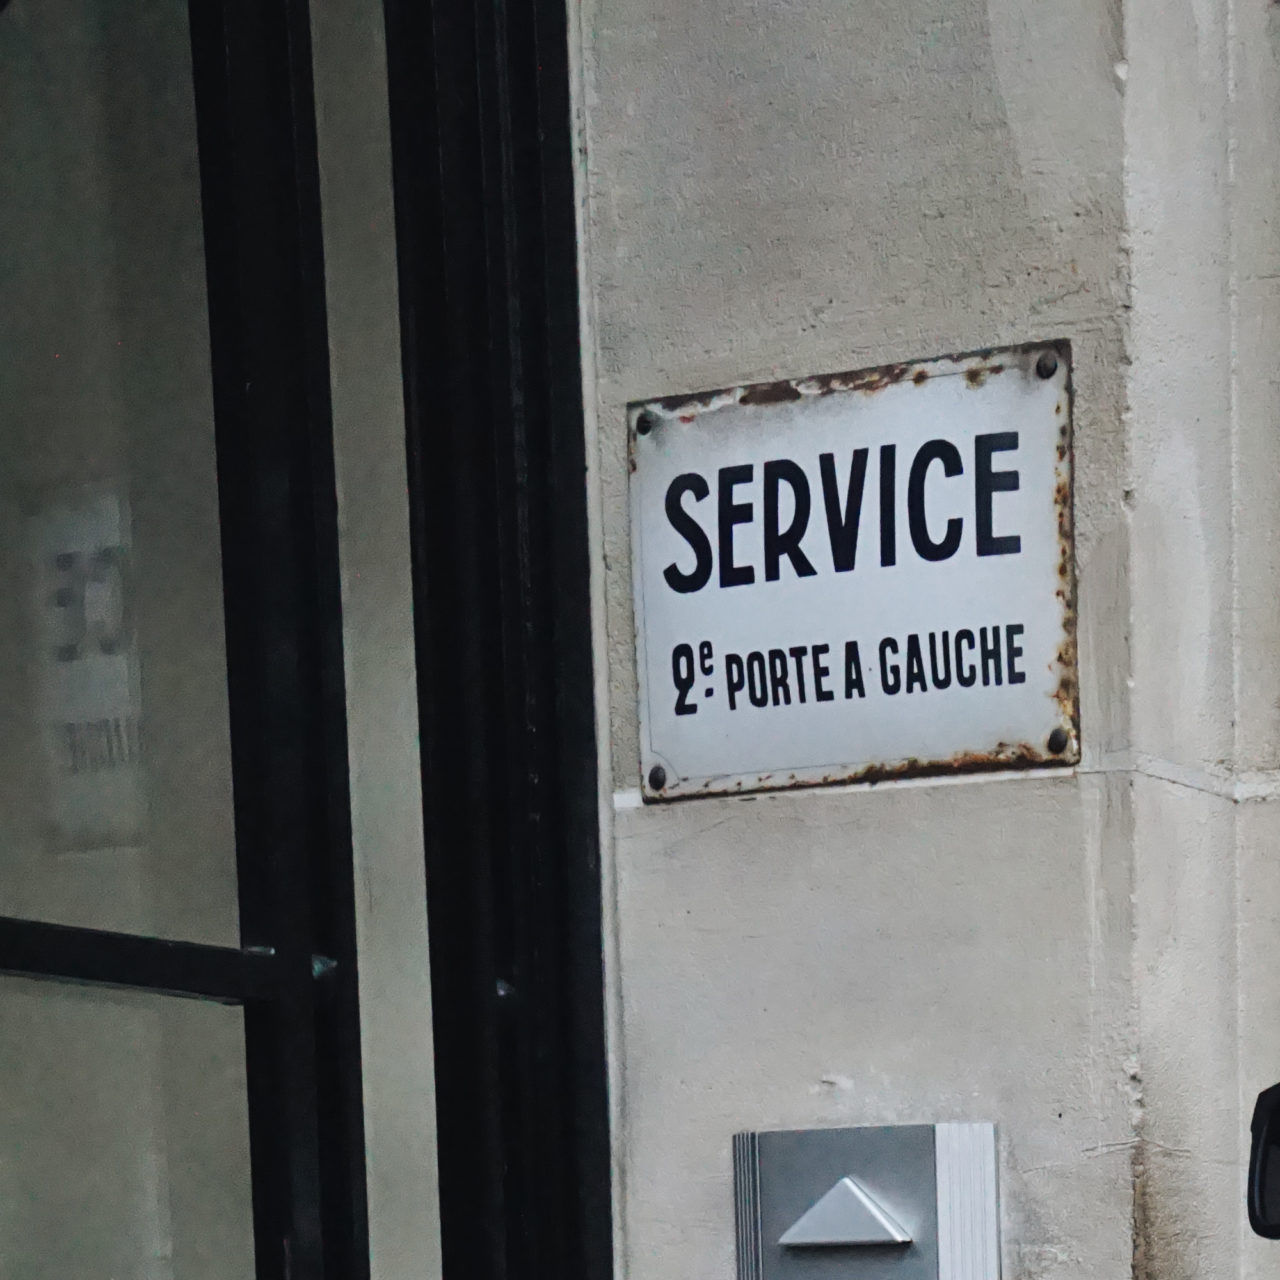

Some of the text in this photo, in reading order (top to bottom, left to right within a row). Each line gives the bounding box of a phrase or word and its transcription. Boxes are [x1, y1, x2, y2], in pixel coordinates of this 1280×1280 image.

[663, 431, 1021, 594] SERVICE
[725, 643, 835, 711] PORTE
[844, 640, 866, 700] A
[878, 624, 1026, 696] GAUCHE
